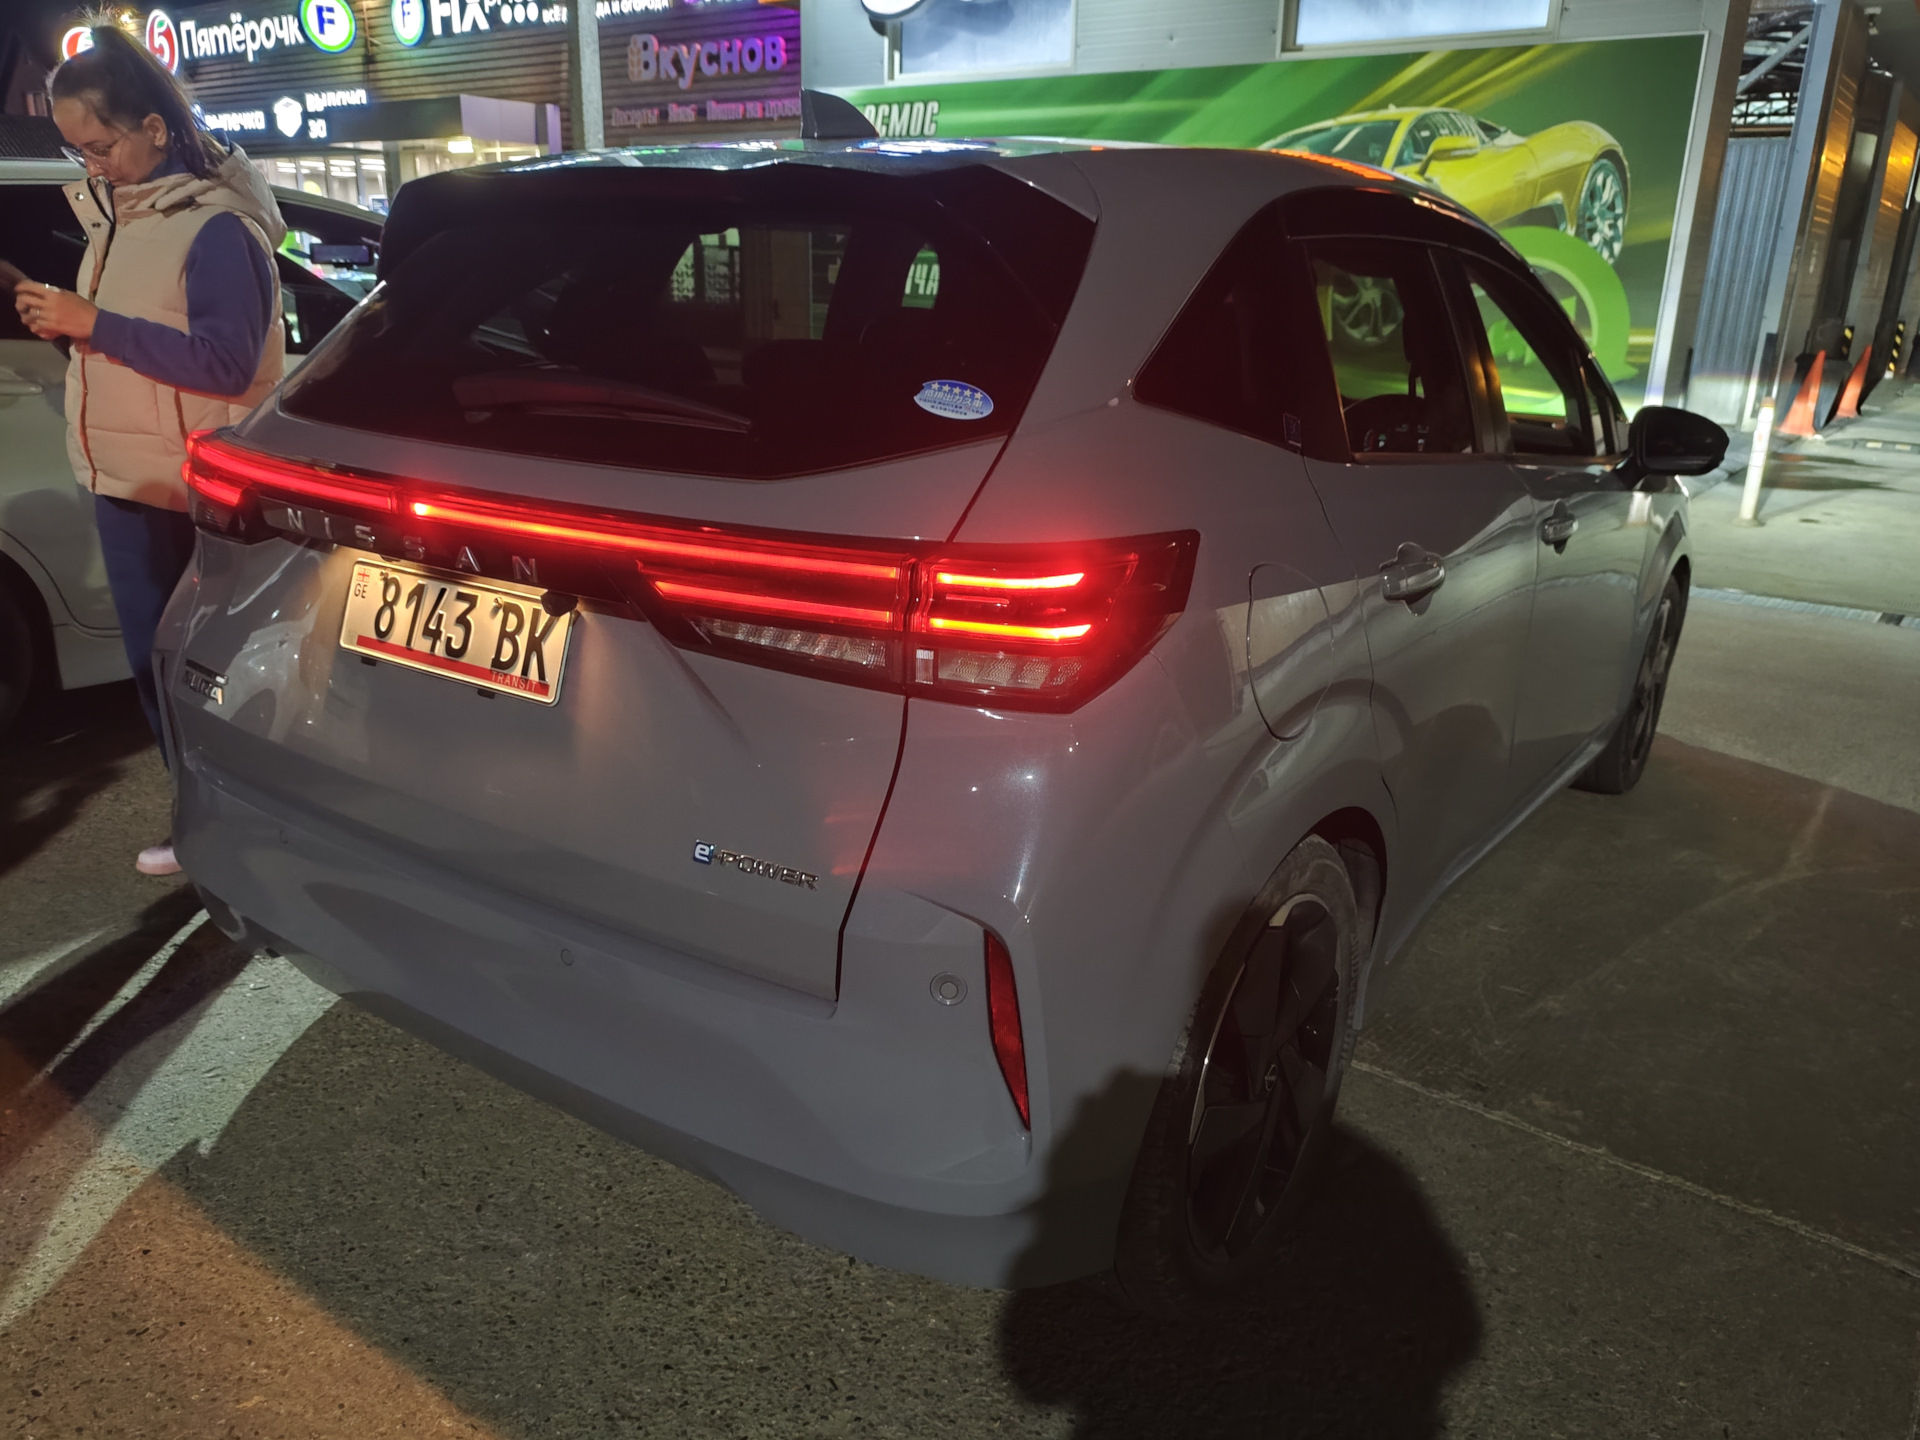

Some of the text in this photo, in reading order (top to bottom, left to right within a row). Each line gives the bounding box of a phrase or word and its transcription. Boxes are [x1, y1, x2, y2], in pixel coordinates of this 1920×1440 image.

[180, 12, 305, 62] Пятёрочк
[316, 5, 335, 35] F
[863, 101, 939, 138] ОСМОС
[287, 506, 538, 583] NISSAN
[353, 583, 368, 599] GE
[374, 575, 557, 683] 8143 BK
[490, 670, 538, 693] TRANSIT
